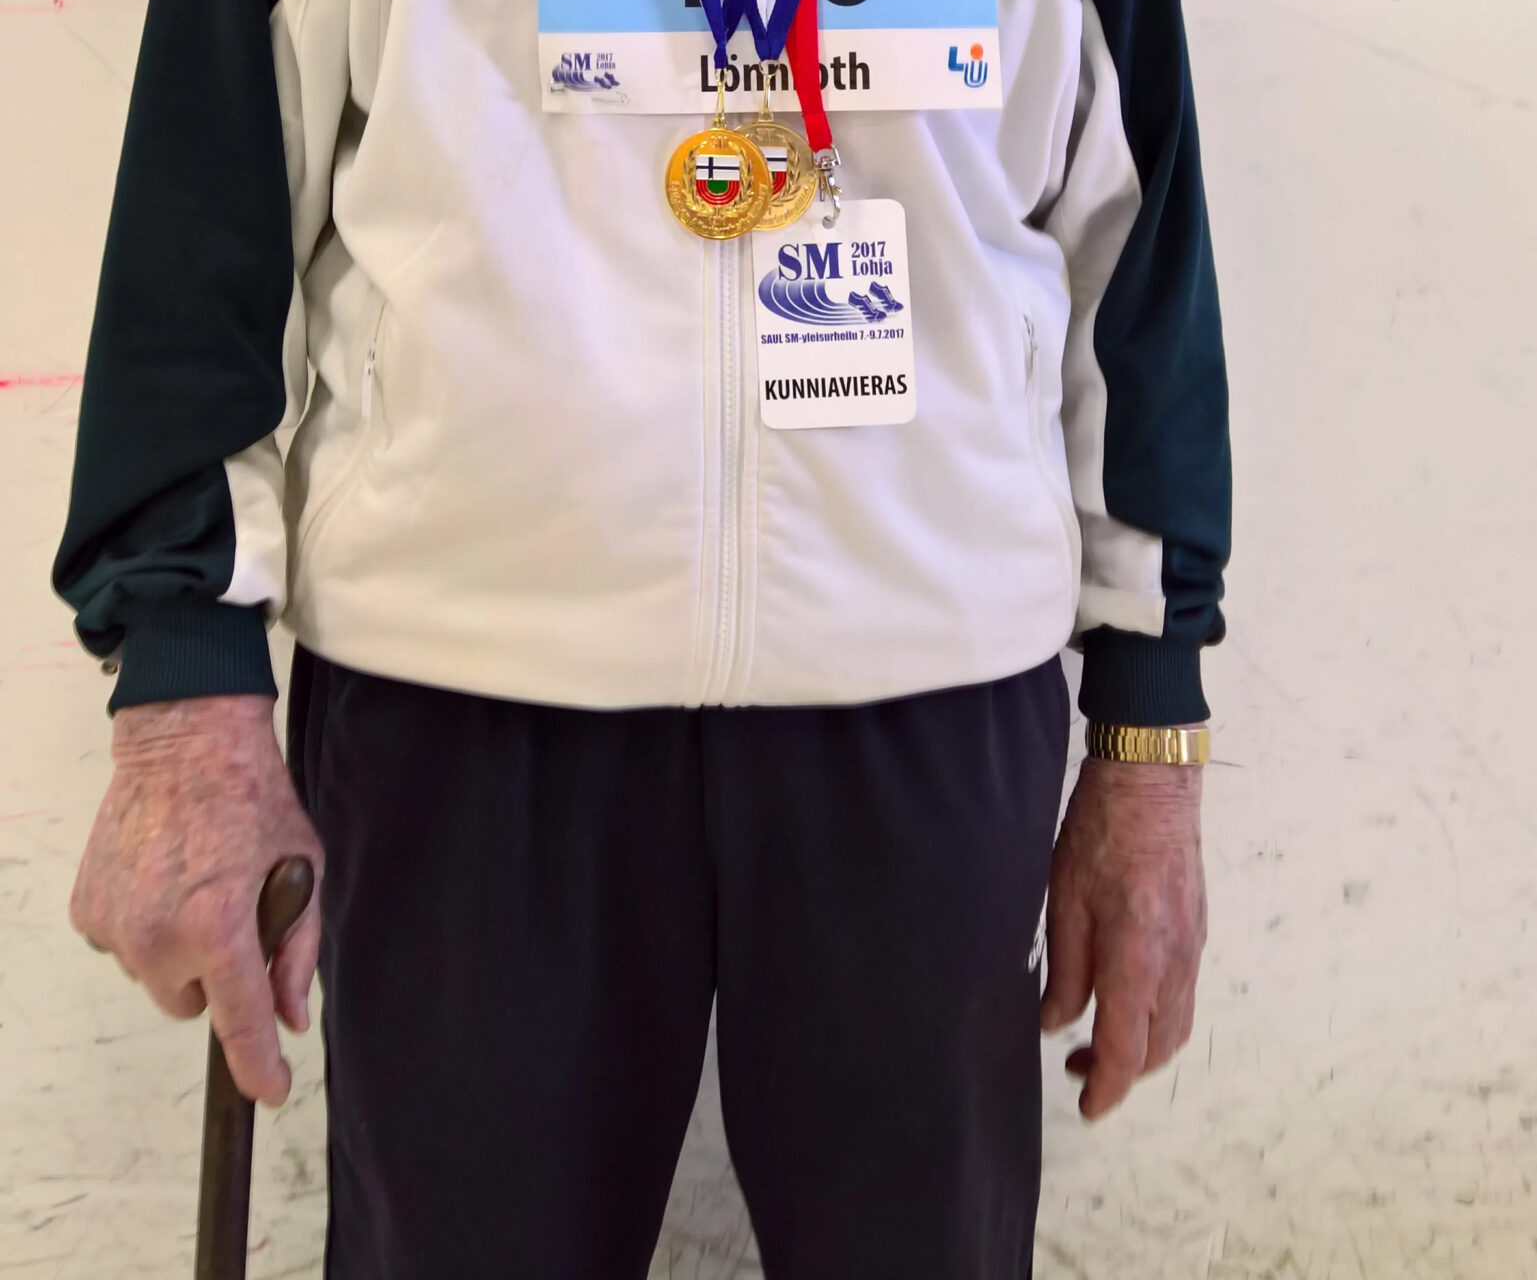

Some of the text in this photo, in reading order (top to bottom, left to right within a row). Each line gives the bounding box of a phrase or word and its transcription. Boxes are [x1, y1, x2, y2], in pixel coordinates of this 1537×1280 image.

[561, 53, 593, 70] SM
[700, 52, 870, 92] Lönnth
[851, 241, 886, 258] 2017
[777, 242, 843, 281] SM
[852, 259, 893, 276] Lohja
[761, 334, 783, 344] SAUL
[765, 374, 908, 400] KUNNIAVIERAS
